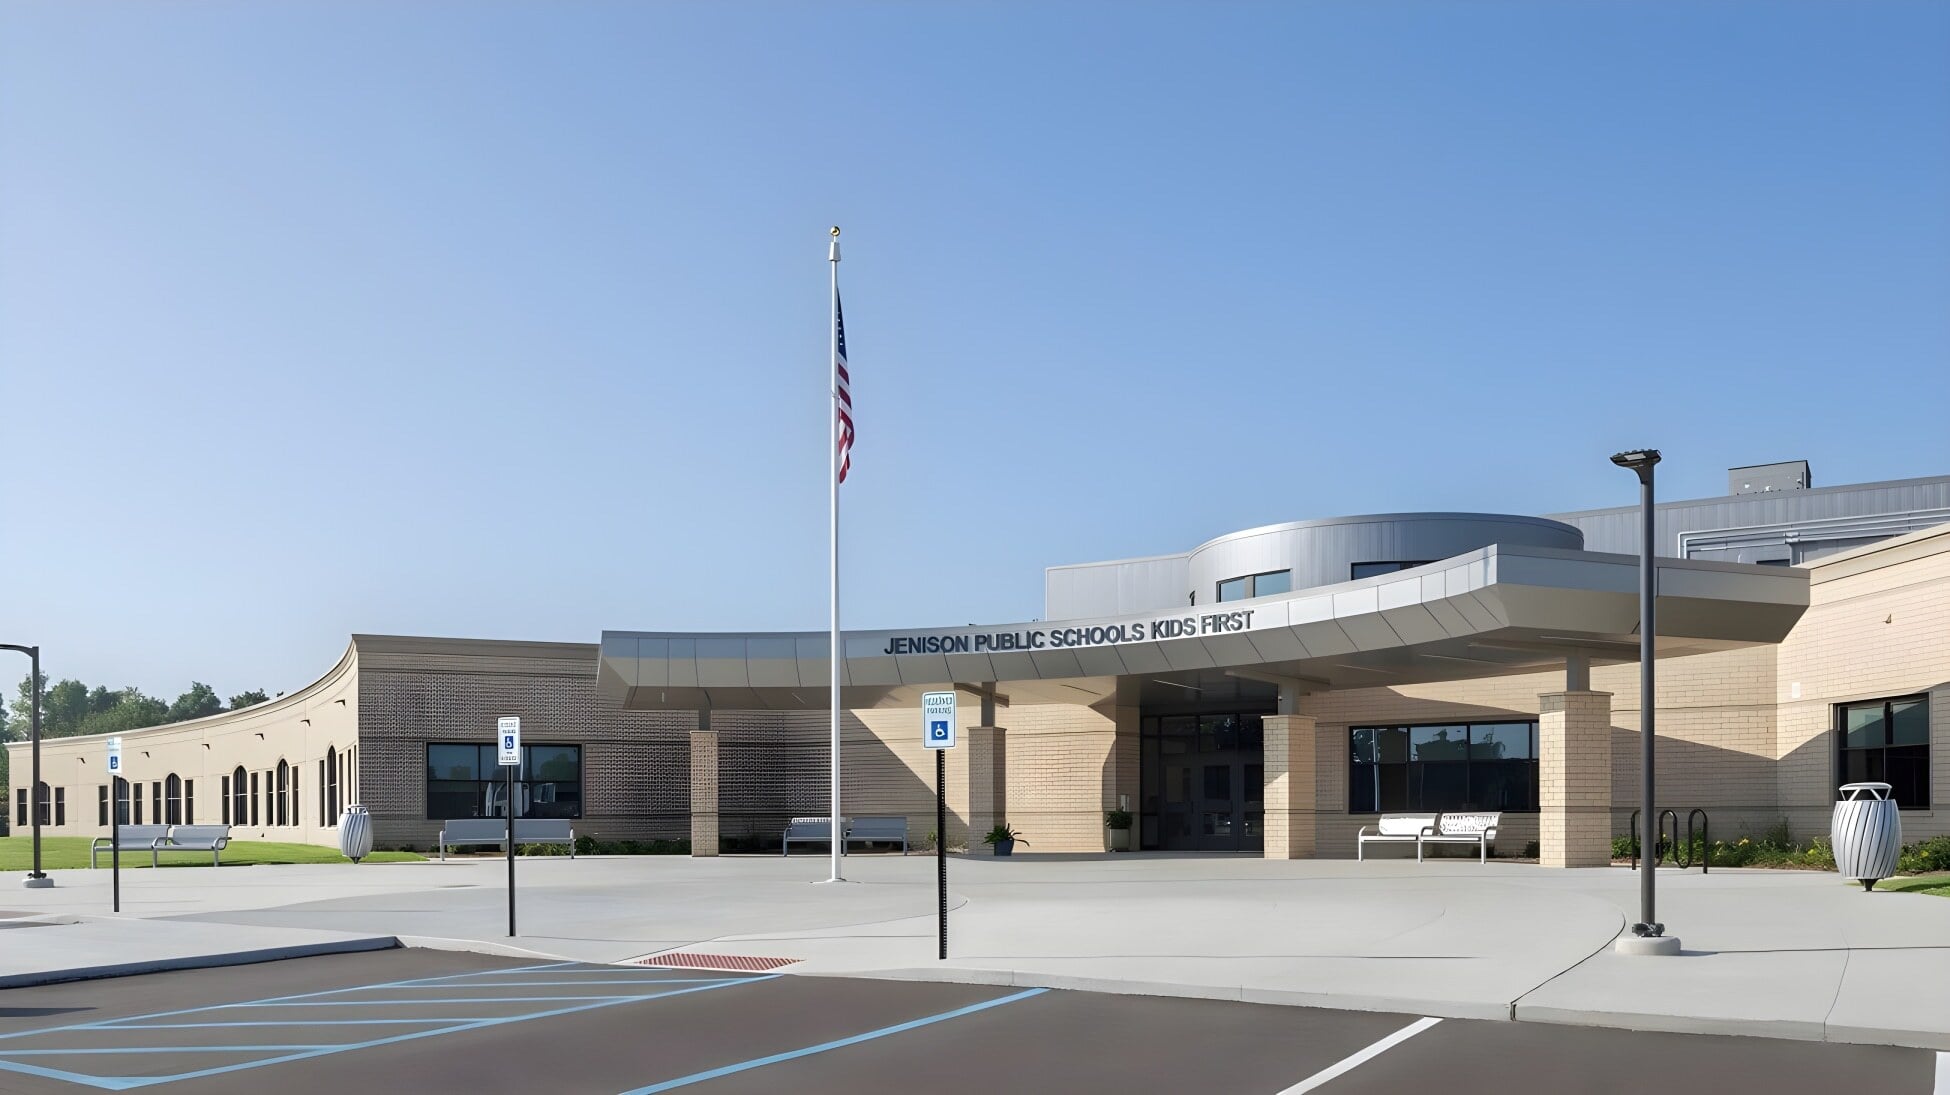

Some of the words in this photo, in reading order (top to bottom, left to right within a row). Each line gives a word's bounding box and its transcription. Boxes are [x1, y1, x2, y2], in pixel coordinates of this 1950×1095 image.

[884, 635, 969, 655] JENISON
[974, 630, 1045, 651] PUBLIC
[1050, 623, 1145, 647] SCHOOLS
[1151, 617, 1197, 640] KIDS
[1201, 610, 1254, 634] FIRST
